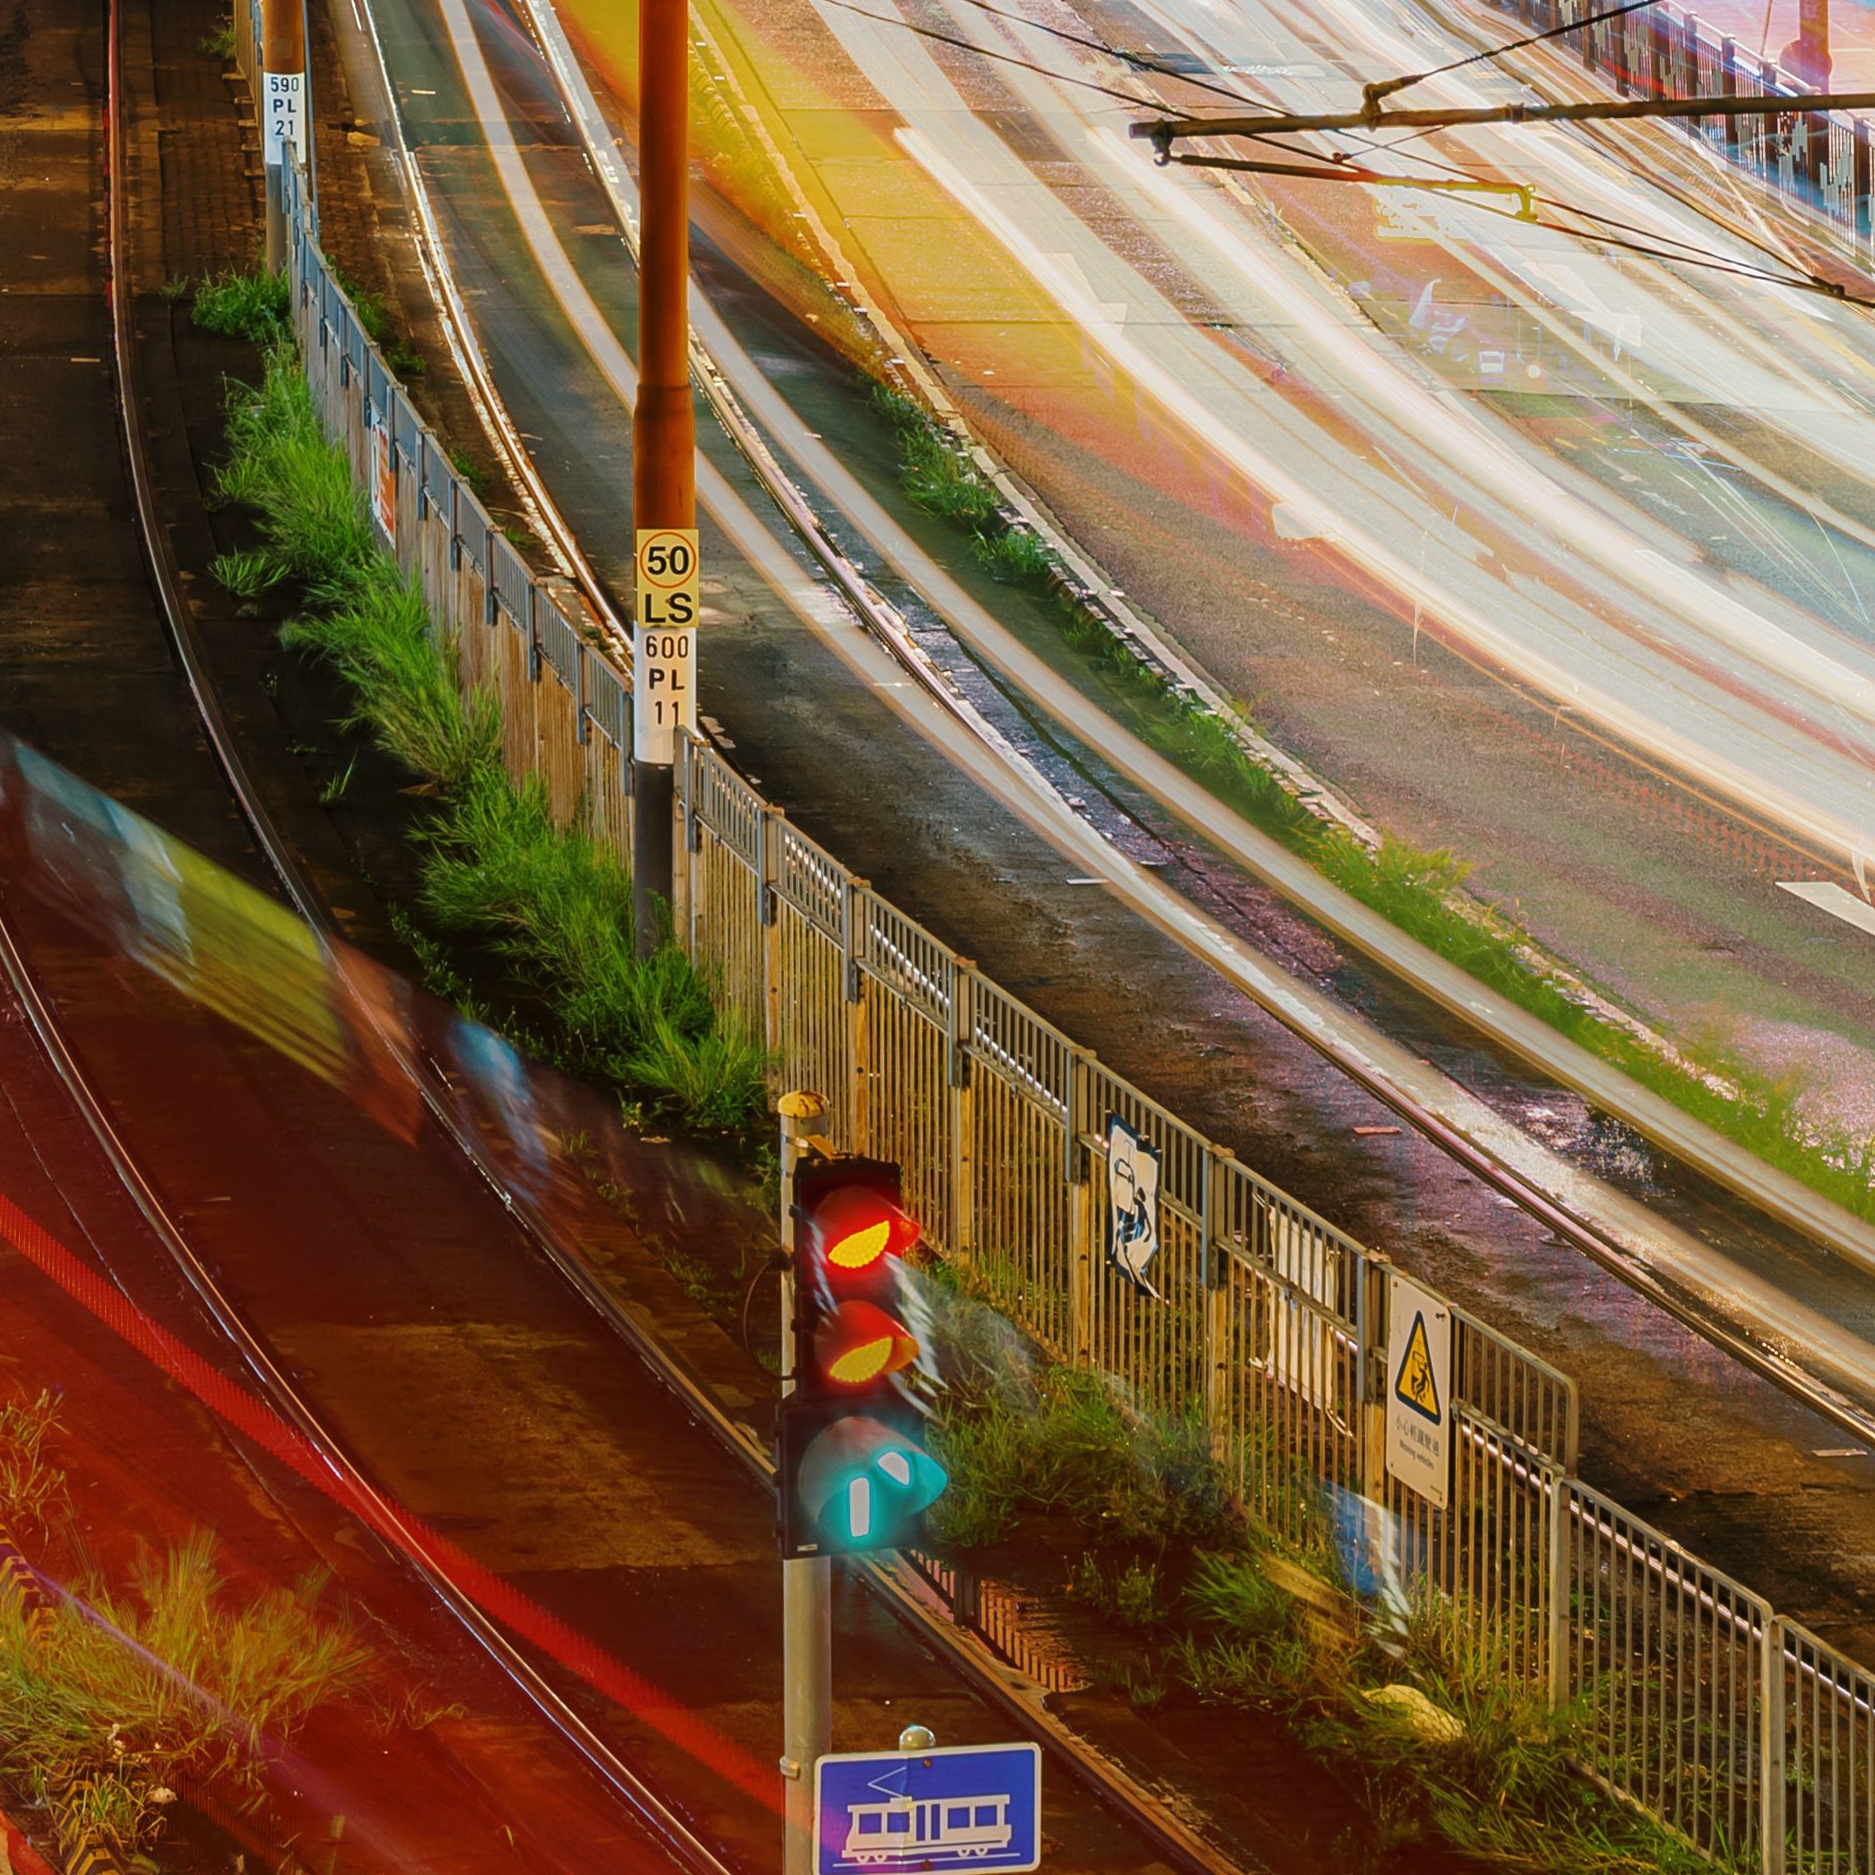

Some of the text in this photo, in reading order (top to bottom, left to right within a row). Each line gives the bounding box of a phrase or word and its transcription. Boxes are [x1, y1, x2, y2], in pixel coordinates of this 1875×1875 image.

[270, 77, 300, 93] 590
[275, 120, 295, 136] 21
[647, 545, 690, 576] 50
[645, 592, 693, 624] LS
[645, 635, 689, 659] 600
[655, 701, 680, 726] 11
